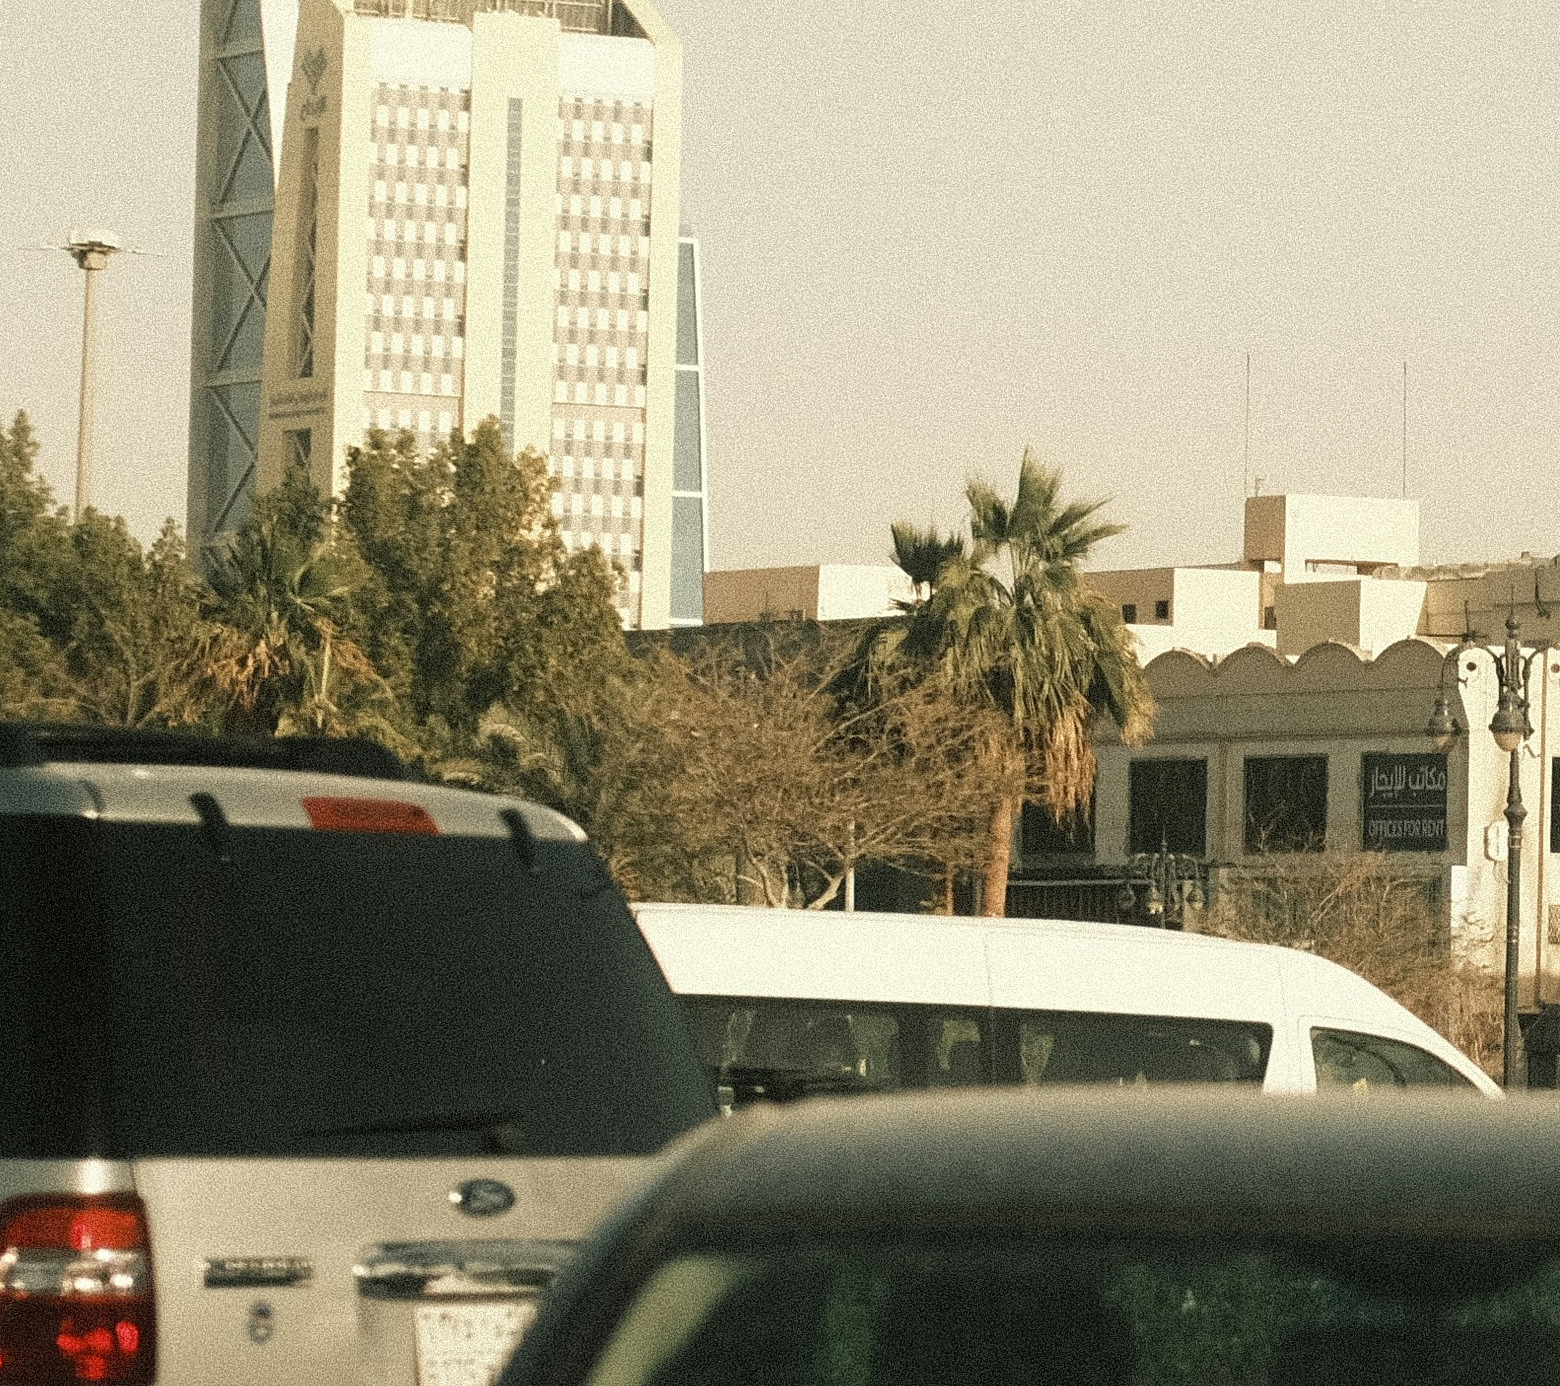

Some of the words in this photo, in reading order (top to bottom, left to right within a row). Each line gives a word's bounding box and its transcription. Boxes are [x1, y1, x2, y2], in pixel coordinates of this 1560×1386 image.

[1408, 765, 1446, 798] مكاتب
[1368, 818, 1402, 839] OFFICES
[1403, 818, 1421, 838] FOR
[1422, 818, 1445, 838] RENT
